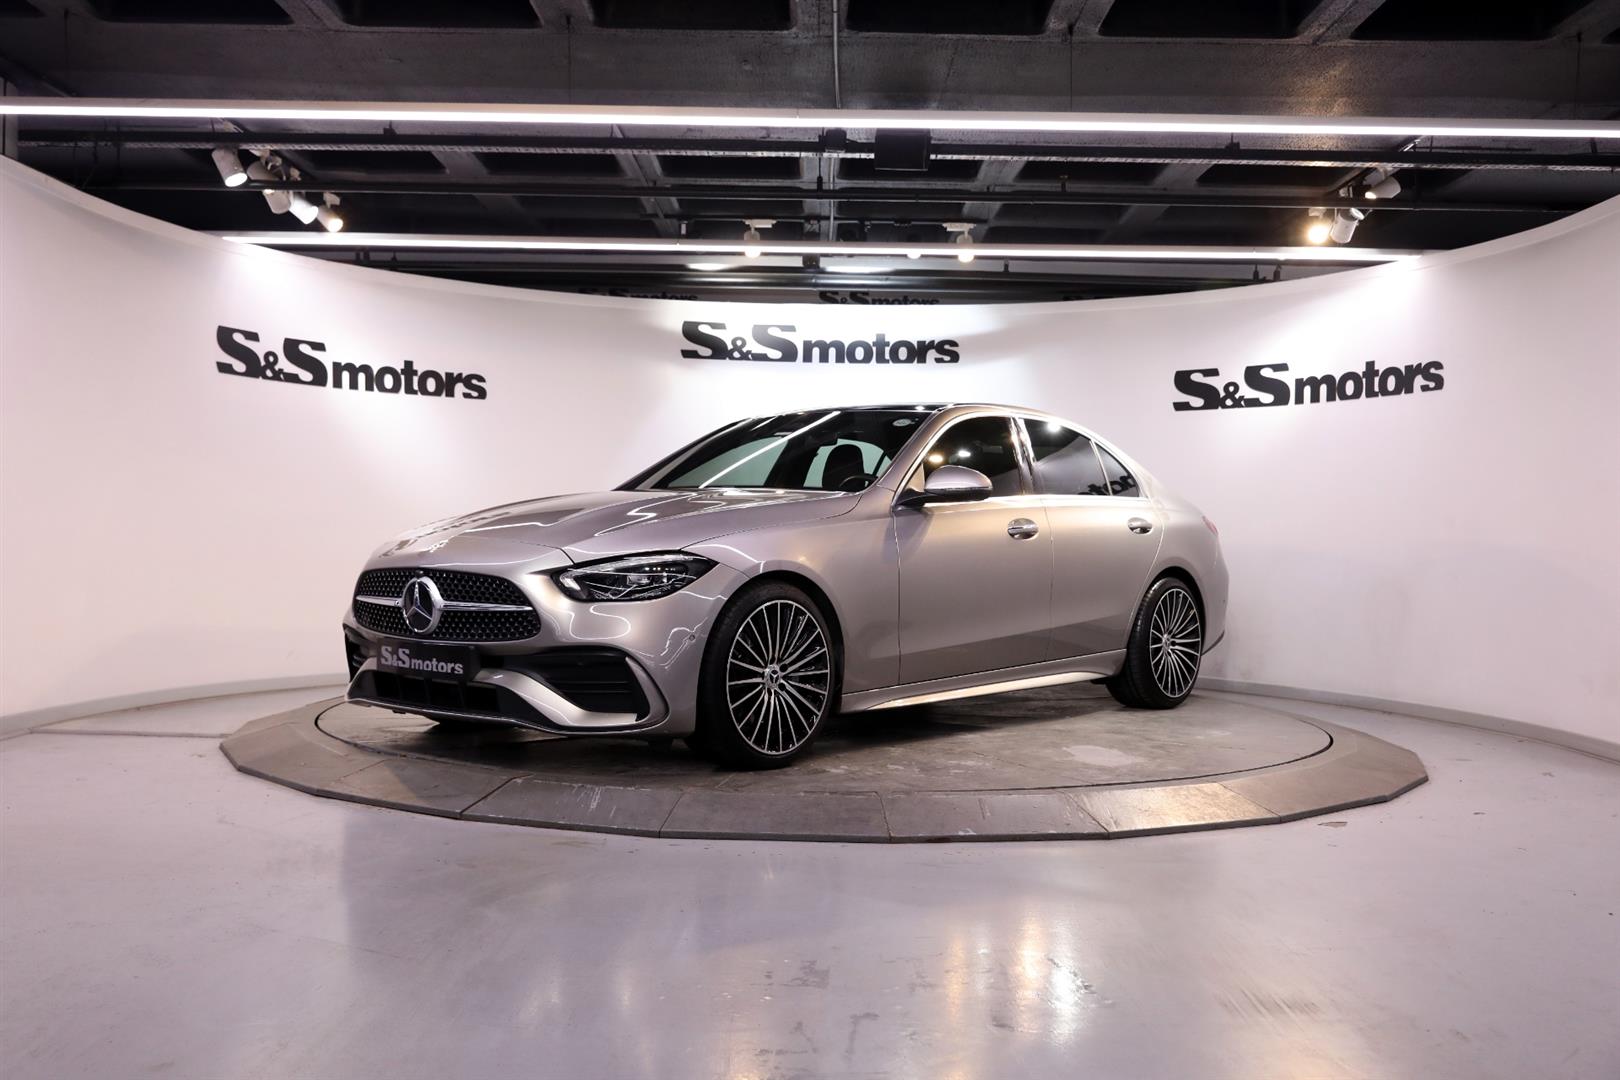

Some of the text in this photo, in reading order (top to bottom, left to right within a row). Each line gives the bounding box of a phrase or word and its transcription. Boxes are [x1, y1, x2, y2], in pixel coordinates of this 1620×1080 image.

[216, 325, 487, 400] S&S motors
[680, 321, 960, 363] S&S motors
[1173, 361, 1444, 411] S&S motors
[381, 645, 464, 674] S&S motors
